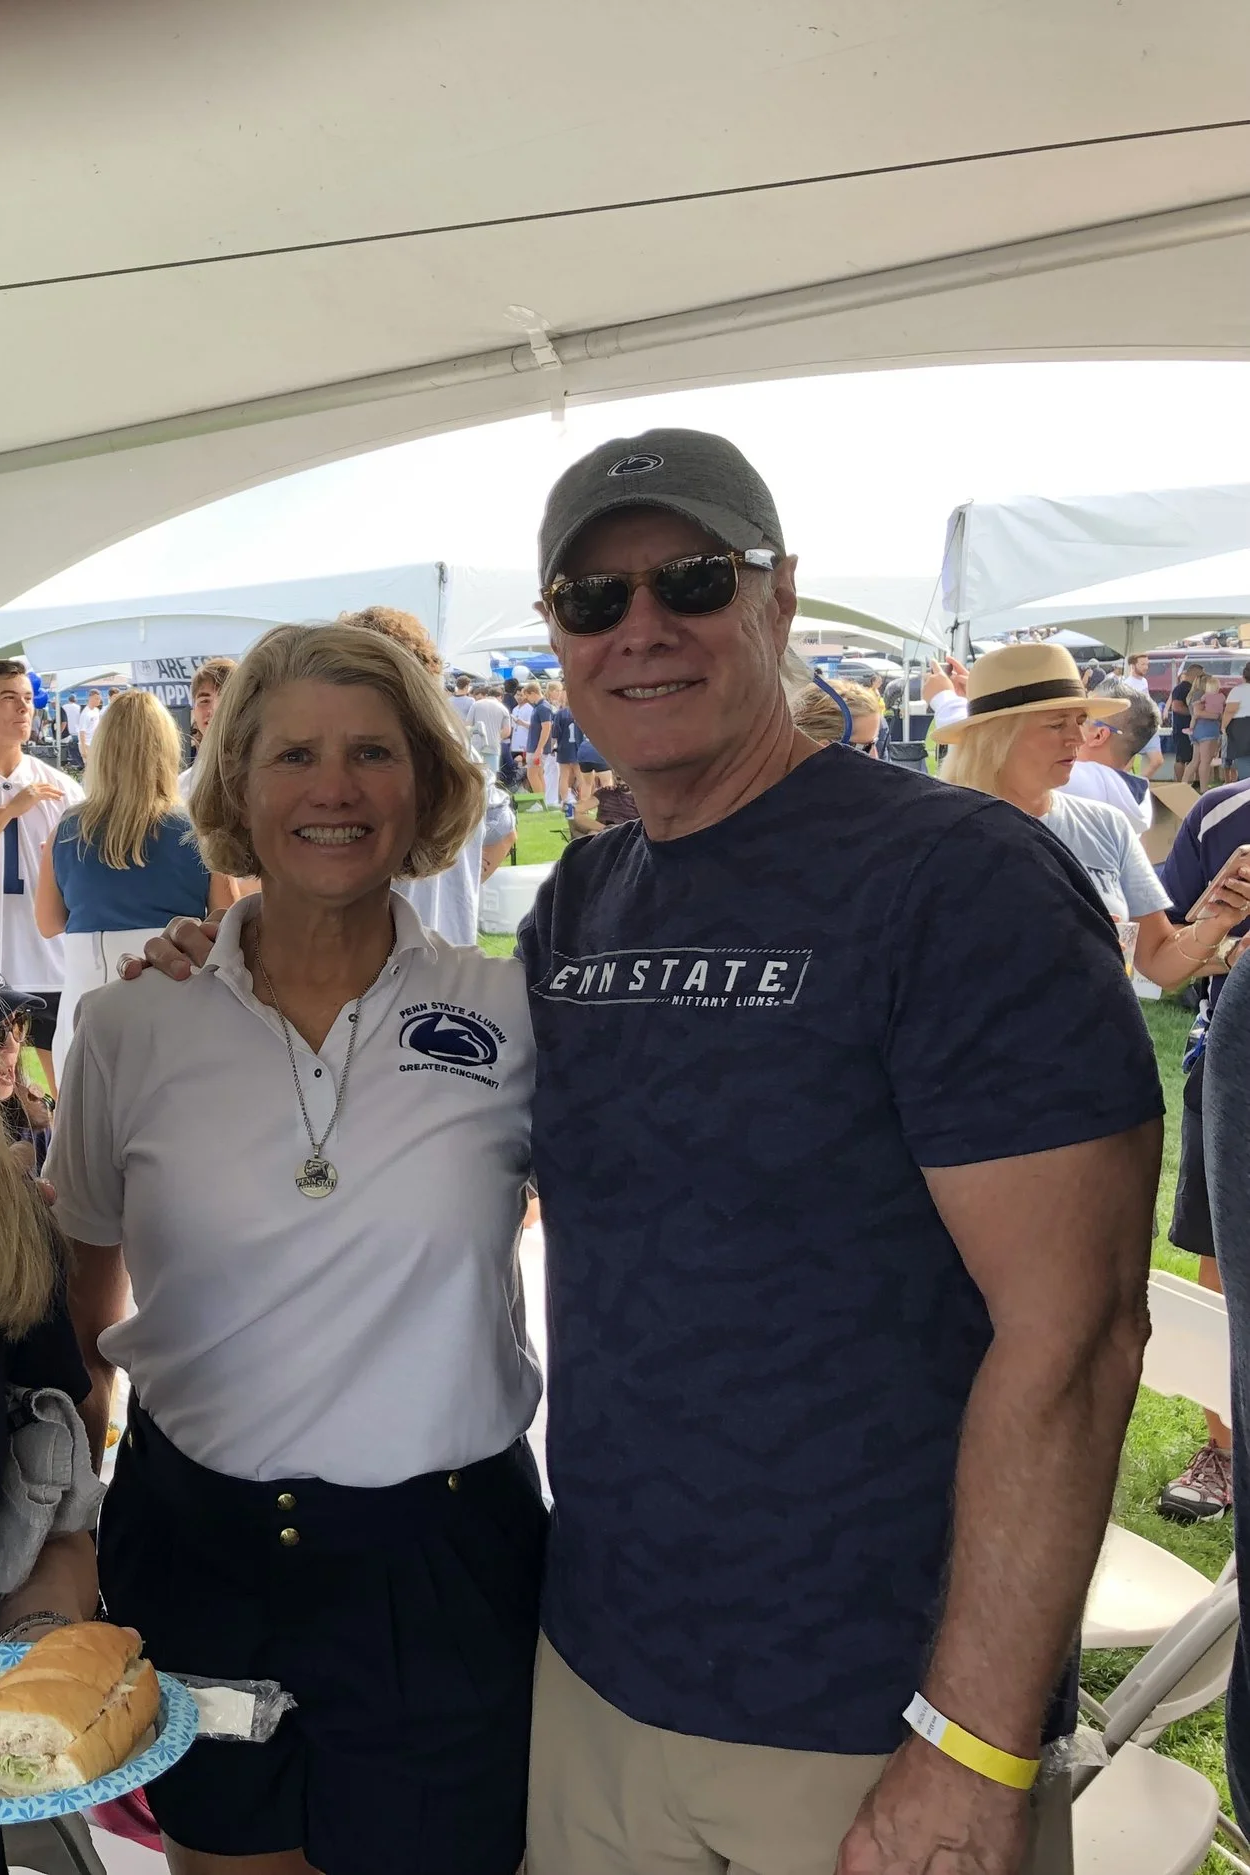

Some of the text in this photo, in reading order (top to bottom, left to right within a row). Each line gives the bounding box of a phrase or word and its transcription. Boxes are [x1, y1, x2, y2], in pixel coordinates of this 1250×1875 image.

[156, 658, 191, 679] ARE
[549, 959, 789, 994] ENN STATE
[671, 995, 775, 1007] NITTANY LIONS
[399, 1001, 508, 1044] PENN STATE ALUMNI
[399, 1063, 500, 1090] GREATER CINCINNATI
